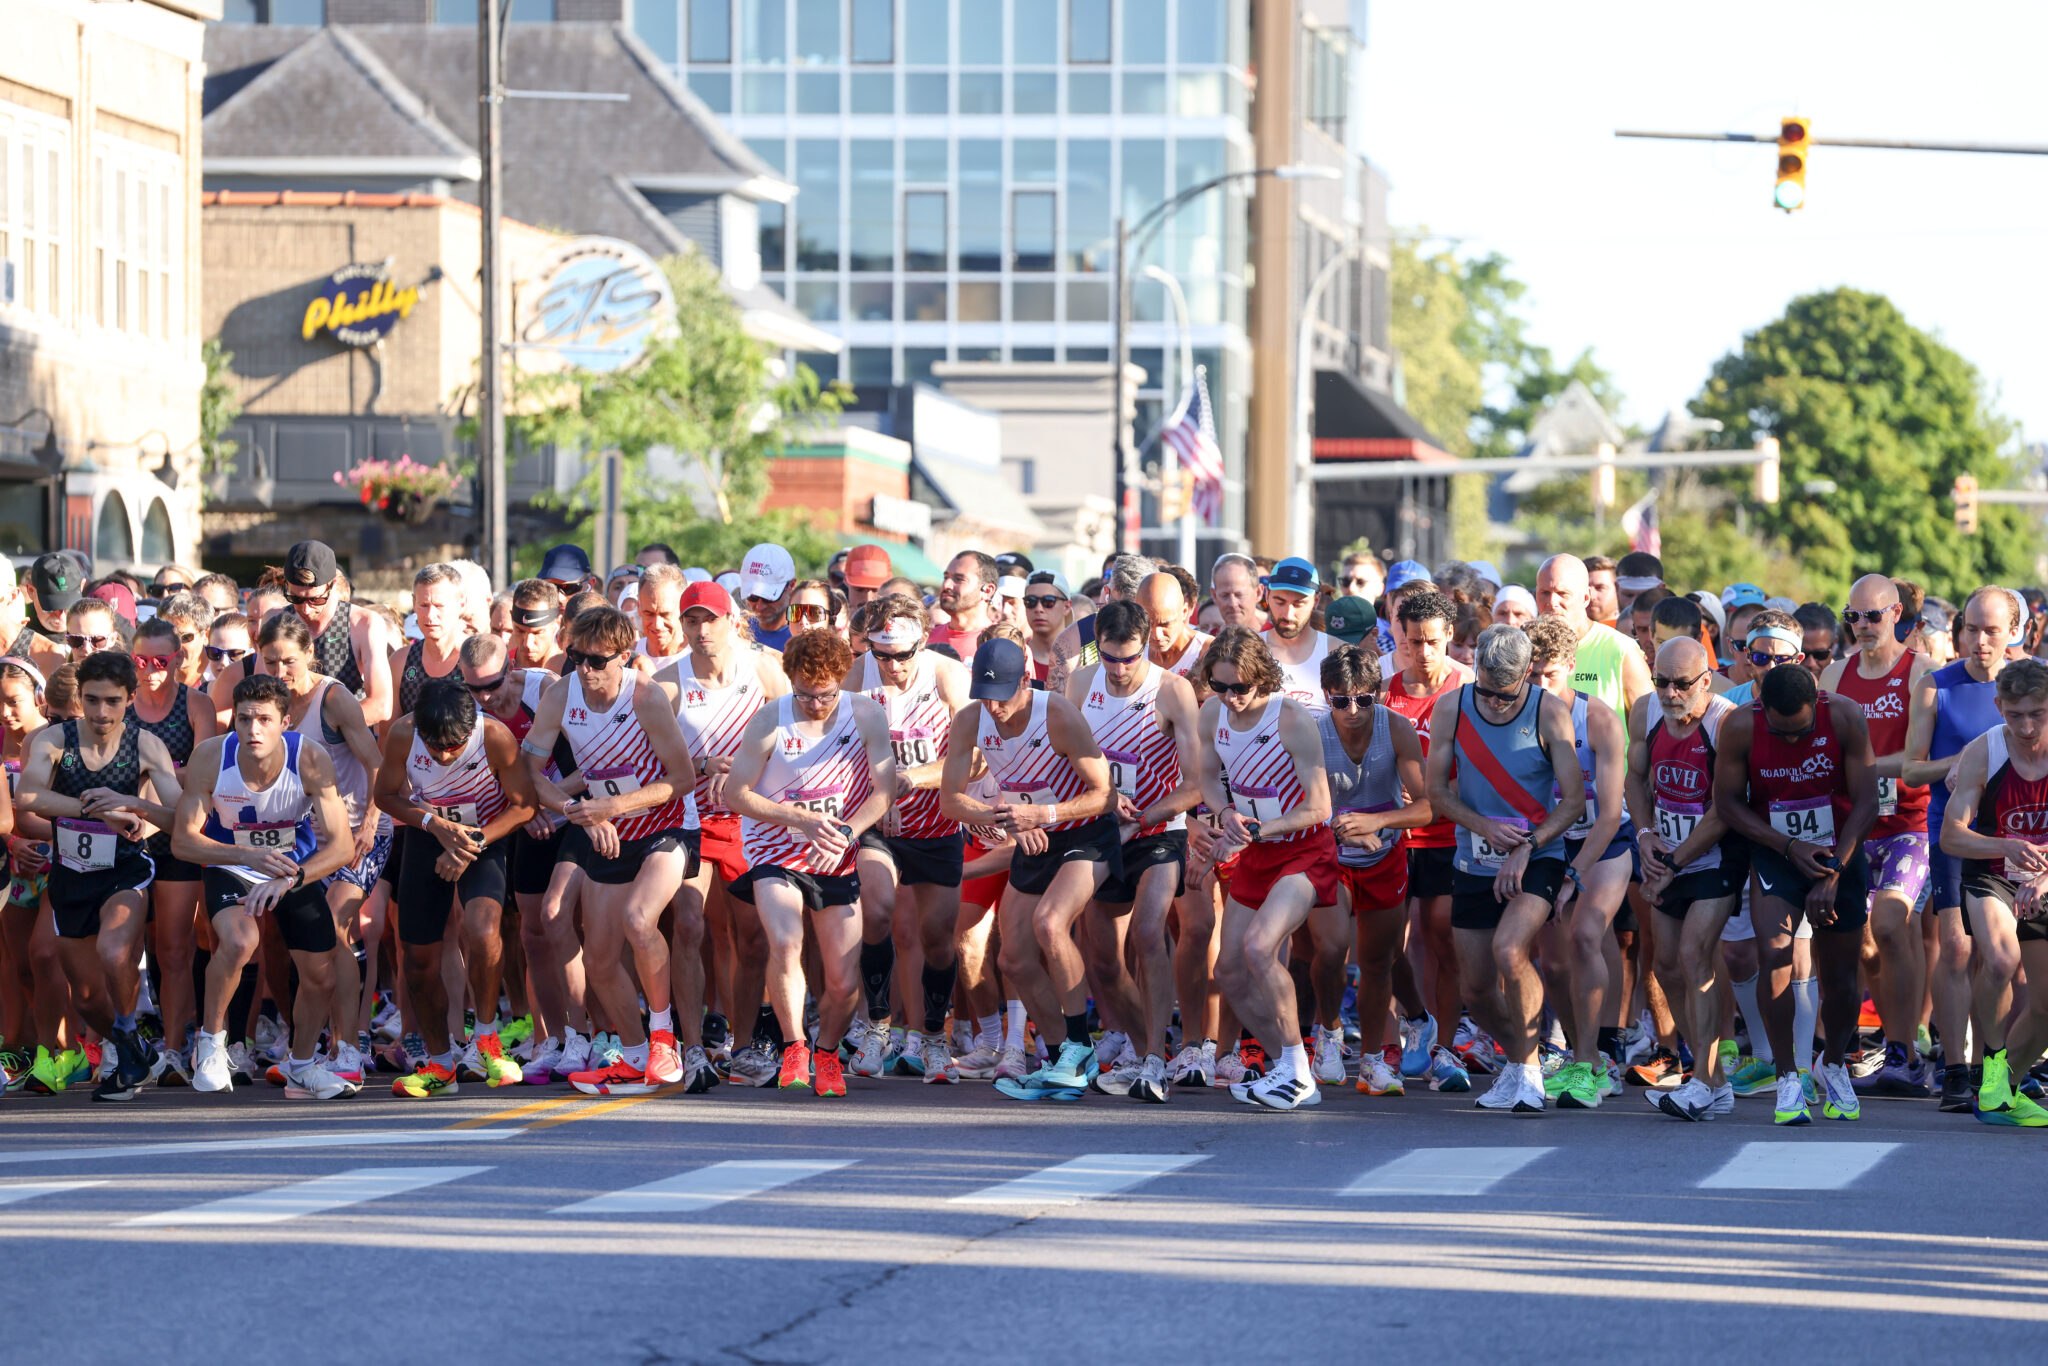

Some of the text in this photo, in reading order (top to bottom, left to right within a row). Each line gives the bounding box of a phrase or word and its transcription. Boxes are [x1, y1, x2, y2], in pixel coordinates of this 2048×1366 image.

[302, 279, 419, 340] Philly
[1575, 673, 1598, 682] ECWA
[1864, 711, 1884, 719] ACING
[1656, 765, 1700, 789] GVH
[1760, 767, 1804, 778] ROADKILL
[433, 806, 462, 823] 15
[1785, 809, 1820, 836] 94
[969, 824, 1006, 842] 496
[1660, 810, 1696, 841] 517
[77, 832, 93, 860] 8
[249, 829, 281, 847] 68
